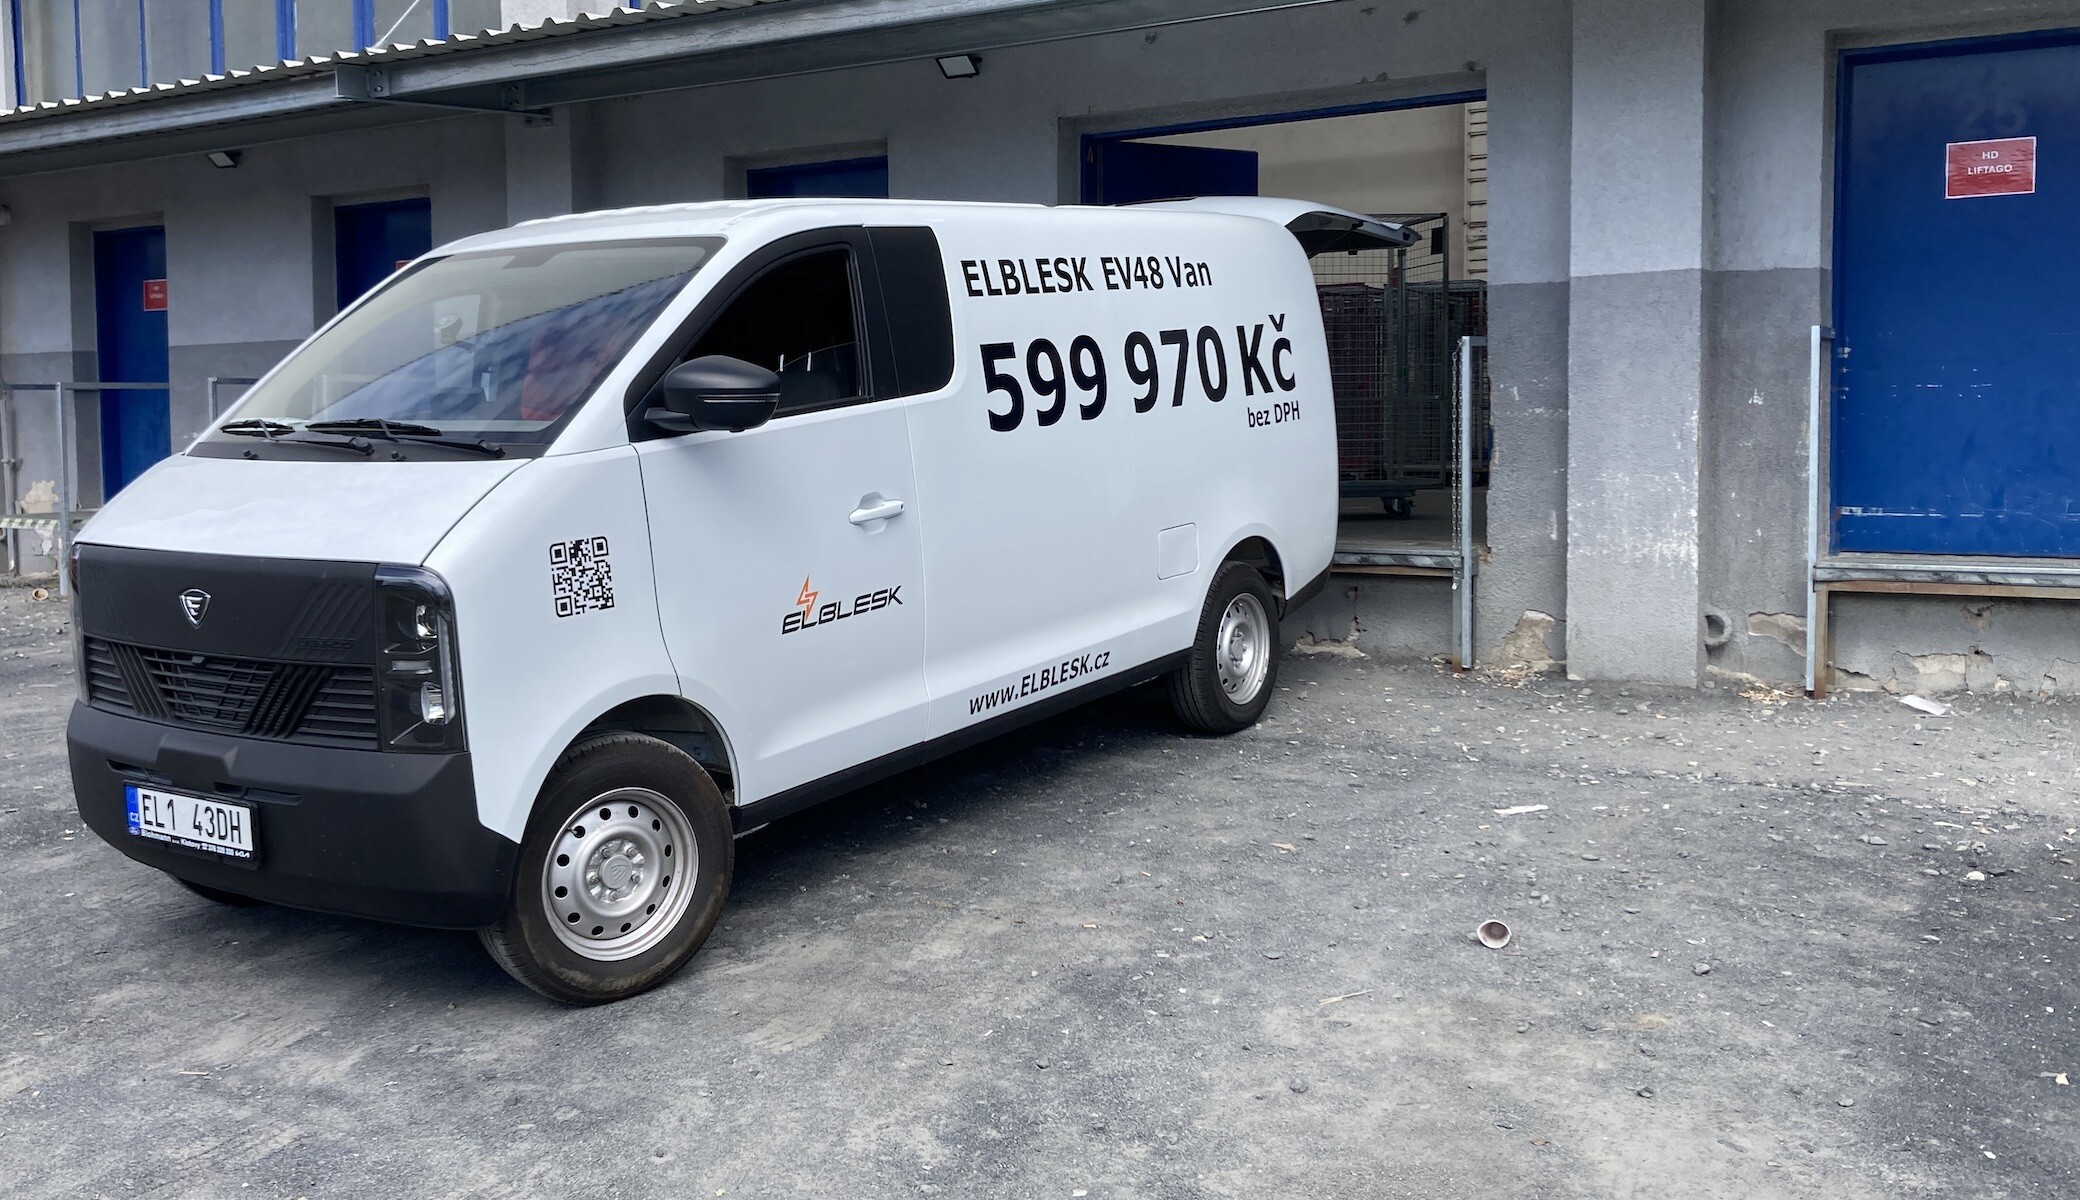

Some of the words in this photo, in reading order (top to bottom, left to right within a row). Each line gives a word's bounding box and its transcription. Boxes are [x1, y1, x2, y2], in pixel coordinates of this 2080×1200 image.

[1967, 163, 2013, 175] LIFTAGO
[1981, 150, 1999, 160] HD
[960, 256, 1094, 297] ELBLESK
[1100, 256, 1164, 290] EV48
[1165, 256, 1213, 288] Van
[979, 334, 1108, 433] 599
[1123, 325, 1228, 414] 970
[1236, 313, 1296, 396] Kč
[1247, 406, 1271, 428] bez
[1274, 400, 1301, 424] DPH
[781, 585, 903, 635] ELBLESK
[969, 650, 1111, 715] www.ELBLESK.cz
[129, 812, 140, 823] CZ
[142, 793, 176, 831] EL1
[193, 803, 242, 844] 43DH
